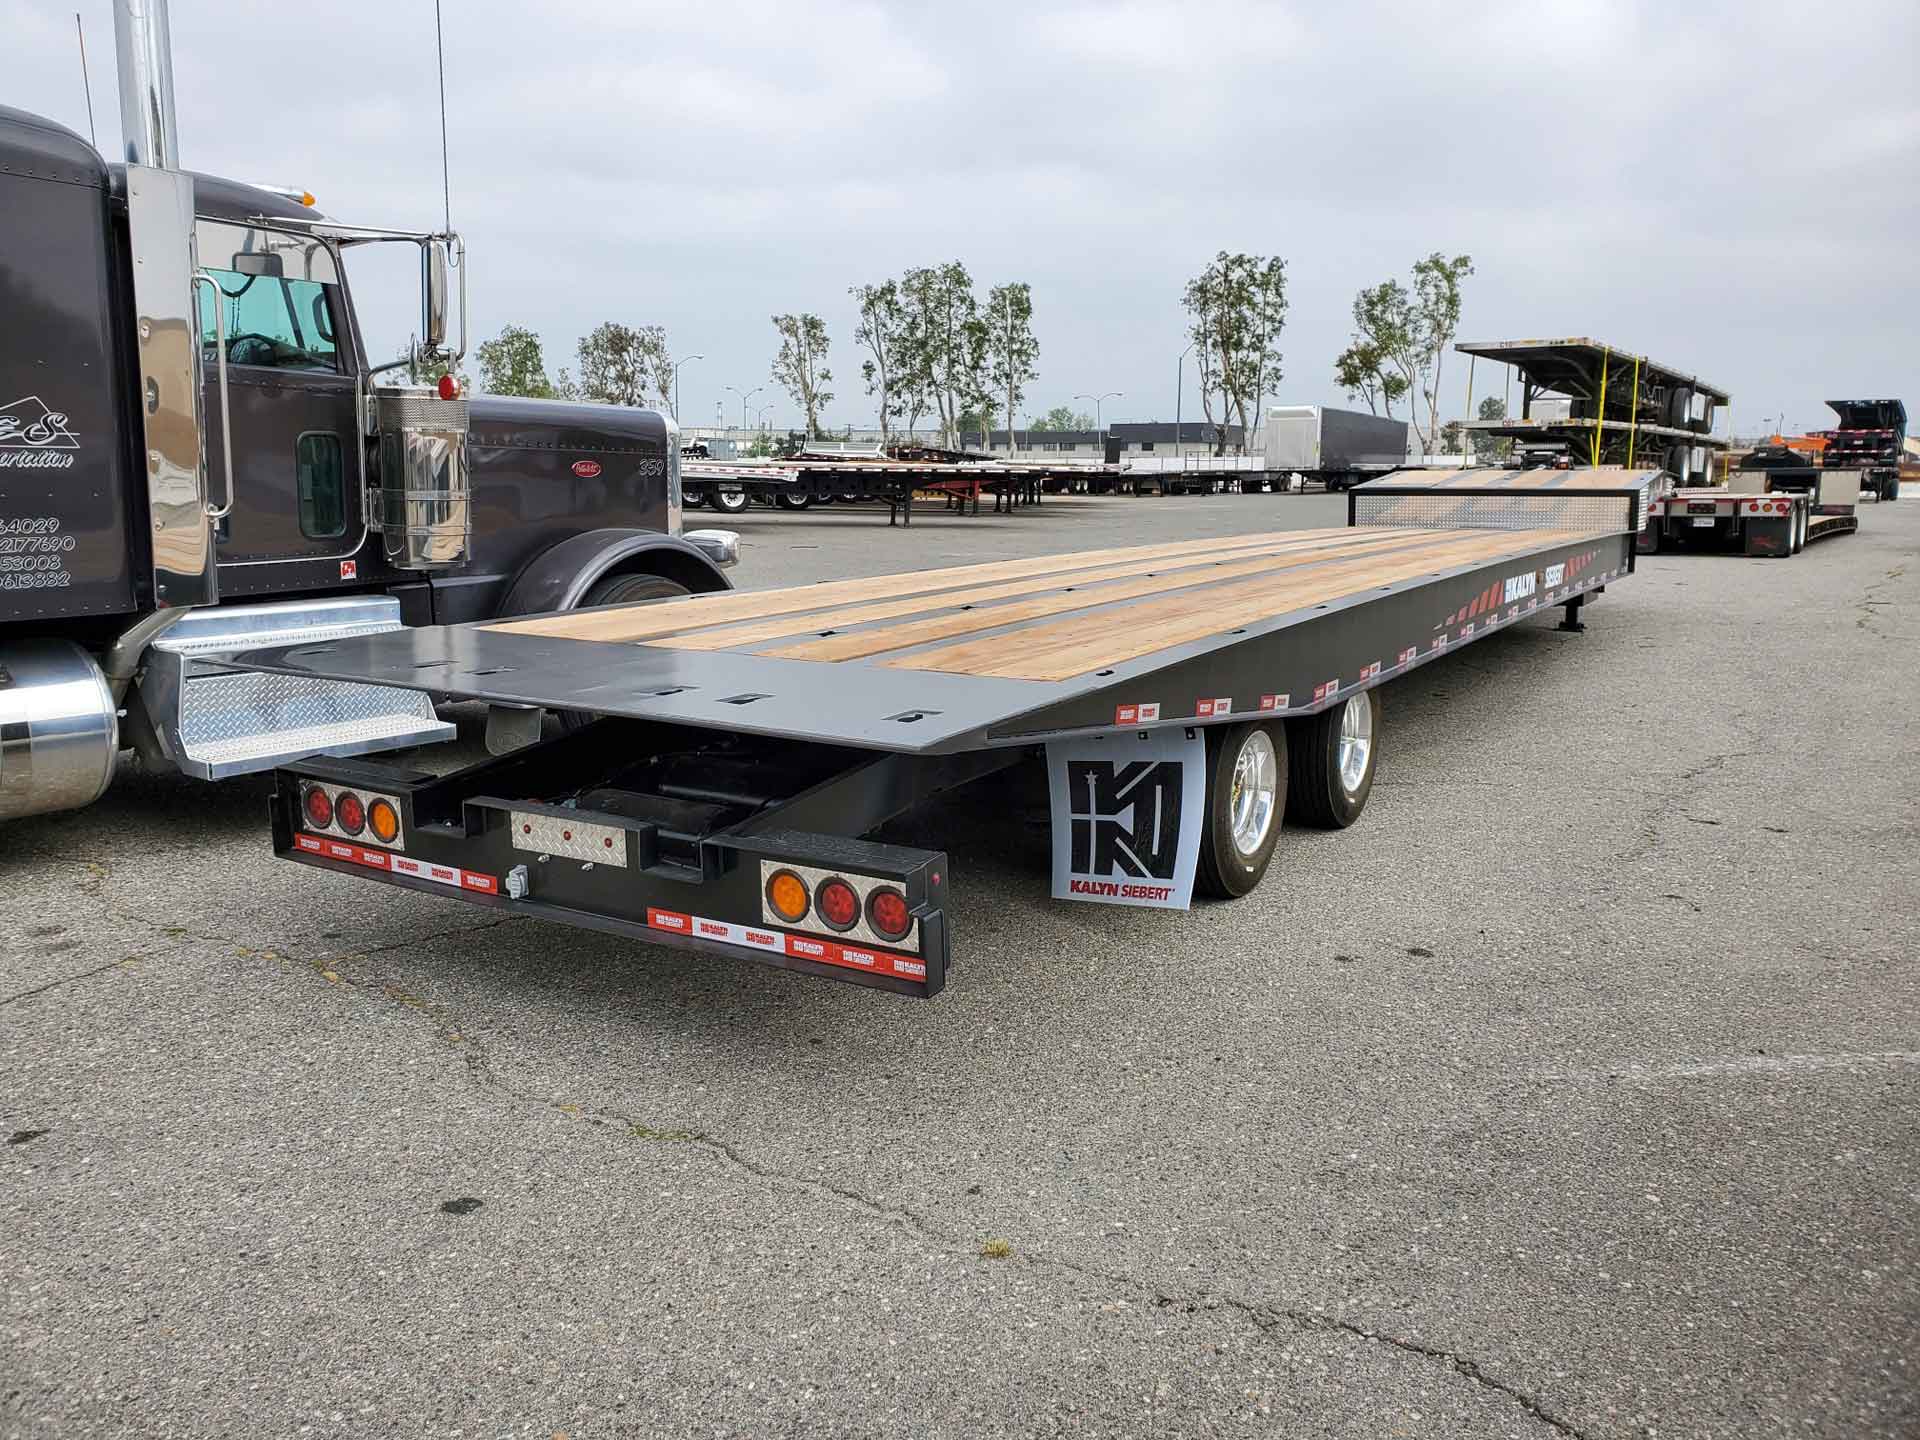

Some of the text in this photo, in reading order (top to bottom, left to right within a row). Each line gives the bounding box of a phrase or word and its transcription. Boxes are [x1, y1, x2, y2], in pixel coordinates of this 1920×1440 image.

[639, 459, 665, 476] 359
[0, 570, 71, 590] 613882
[1070, 879, 1170, 902] KALYN SIEBERT
